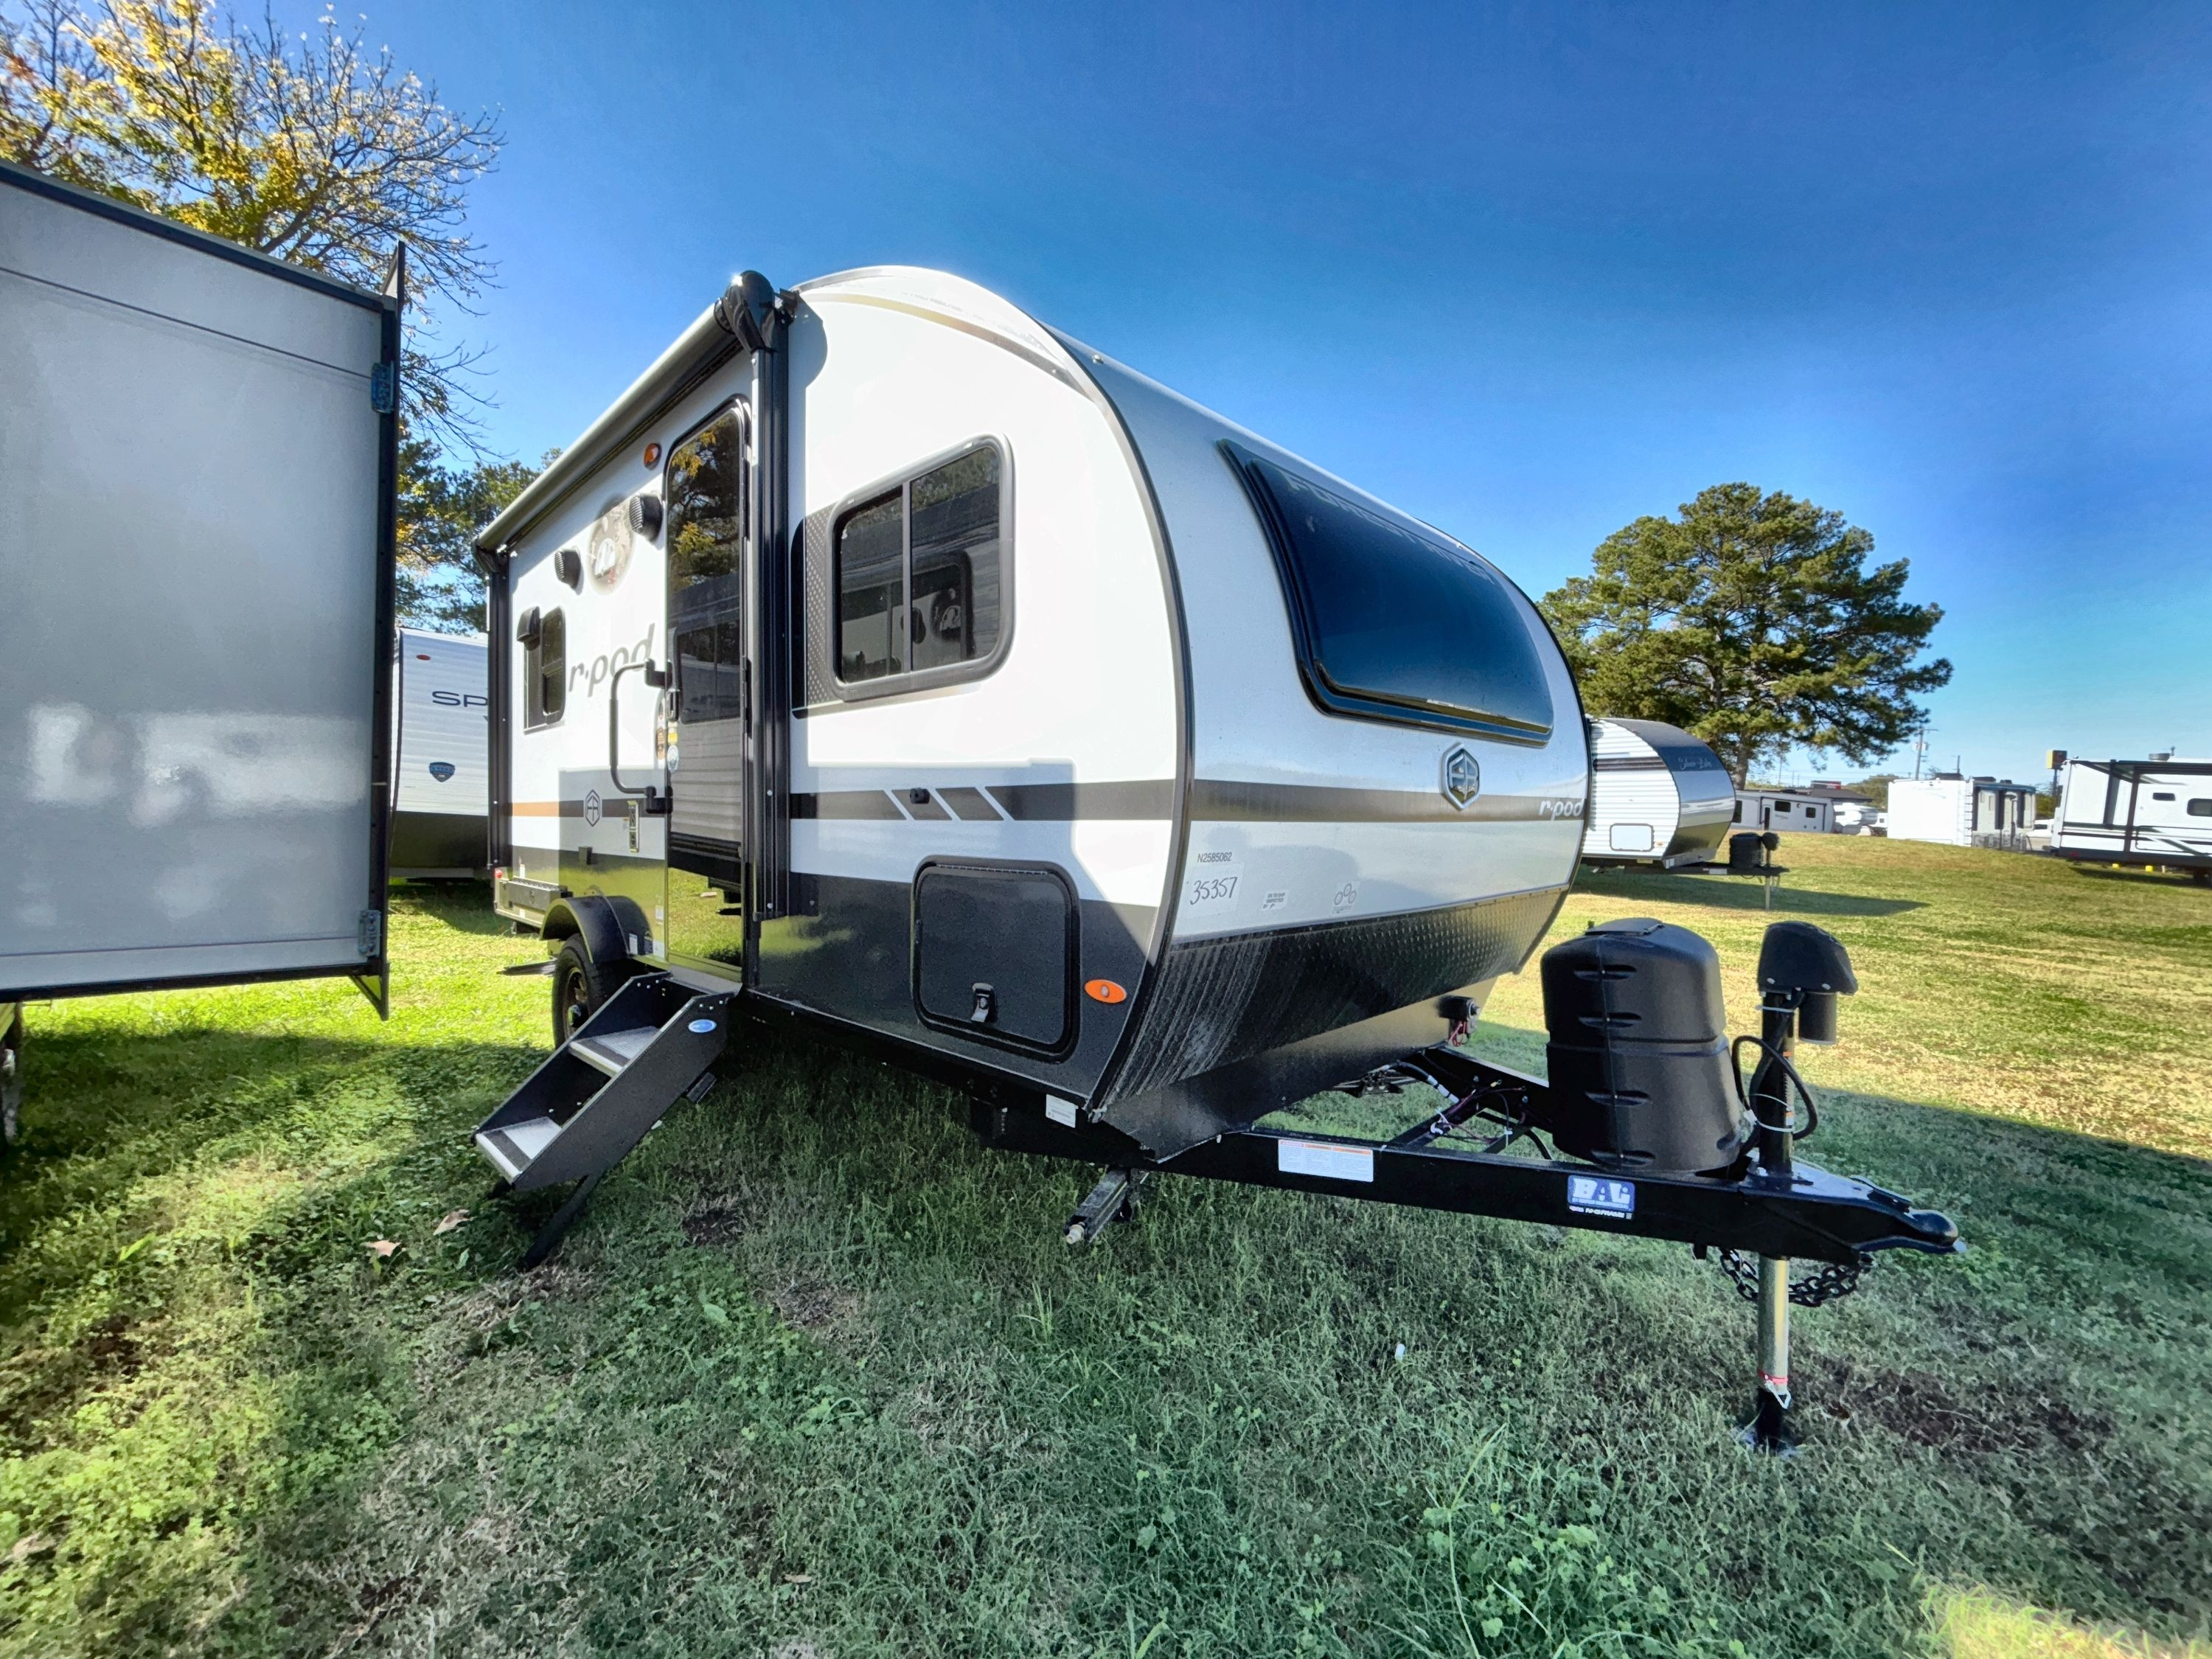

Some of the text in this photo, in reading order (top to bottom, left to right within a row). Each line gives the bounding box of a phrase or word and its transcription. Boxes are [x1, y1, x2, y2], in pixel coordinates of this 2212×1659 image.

[1197, 852, 1233, 863] N2585062
[1190, 877, 1238, 905] 35357
[1572, 1178, 1631, 1205] BAL
